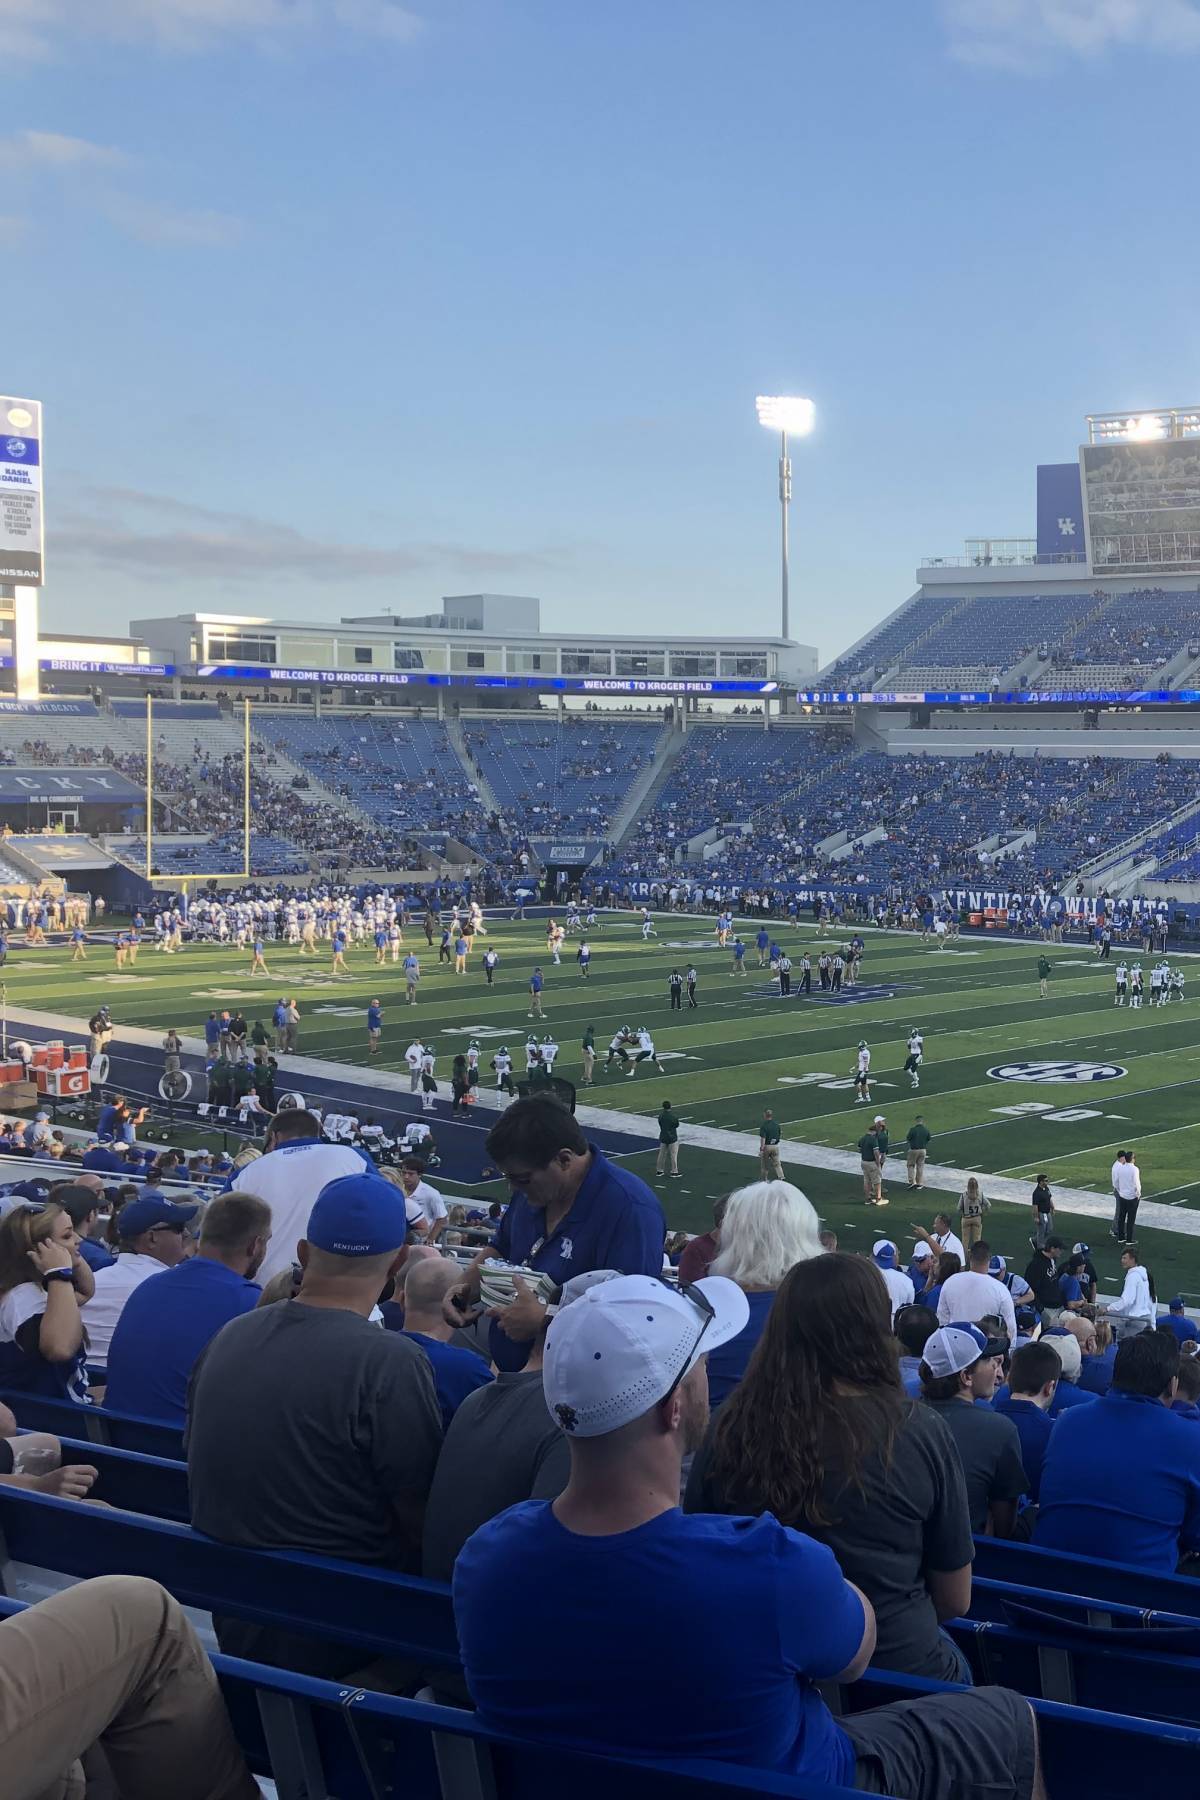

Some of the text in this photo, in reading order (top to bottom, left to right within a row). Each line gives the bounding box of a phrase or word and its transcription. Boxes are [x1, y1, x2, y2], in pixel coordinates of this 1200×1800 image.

[5, 468, 29, 477] KASH
[1, 475, 33, 485] DANIEL
[0, 568, 39, 578] NISSAN
[51, 660, 88, 671] BRING
[90, 662, 101, 671] IT
[270, 669, 408, 684] WELCOME TO KROGER FIELD
[583, 680, 713, 691] WELCOME TO KROGER FIELD
[968, 1205, 979, 1214] 57
[333, 1242, 370, 1251] KENTUCKY
